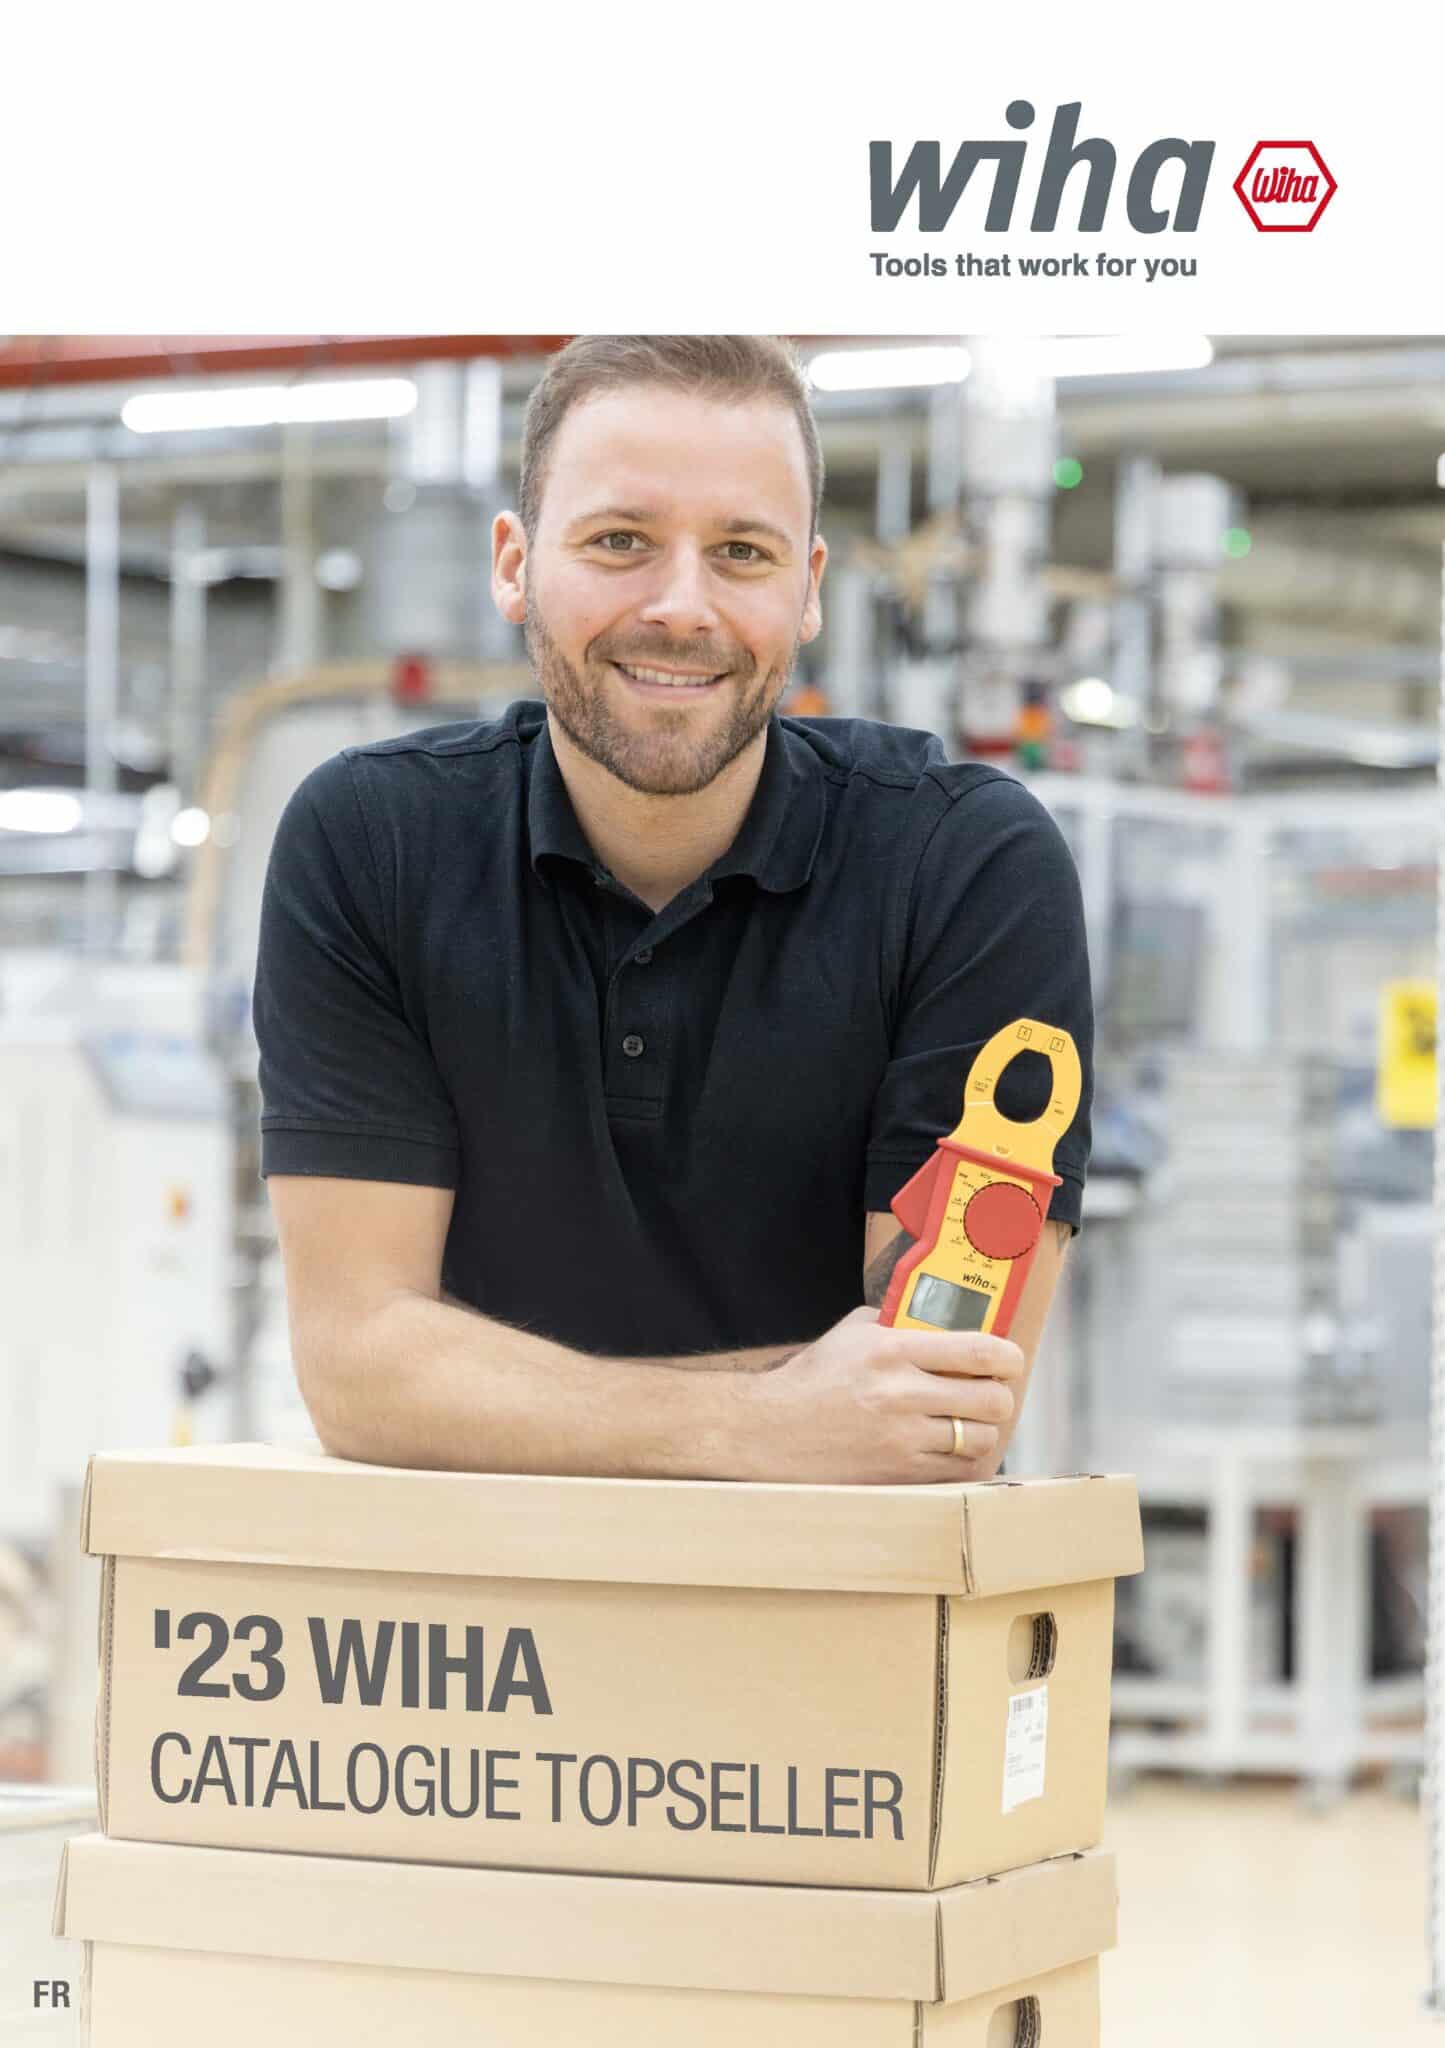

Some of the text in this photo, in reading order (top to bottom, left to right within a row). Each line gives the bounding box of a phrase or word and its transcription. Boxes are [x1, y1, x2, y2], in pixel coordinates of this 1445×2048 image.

[963, 1272, 990, 1289] wiha
[155, 1610, 553, 1715] '23 WIHA
[151, 1733, 904, 1841] CATALOGUE TOPSELLER
